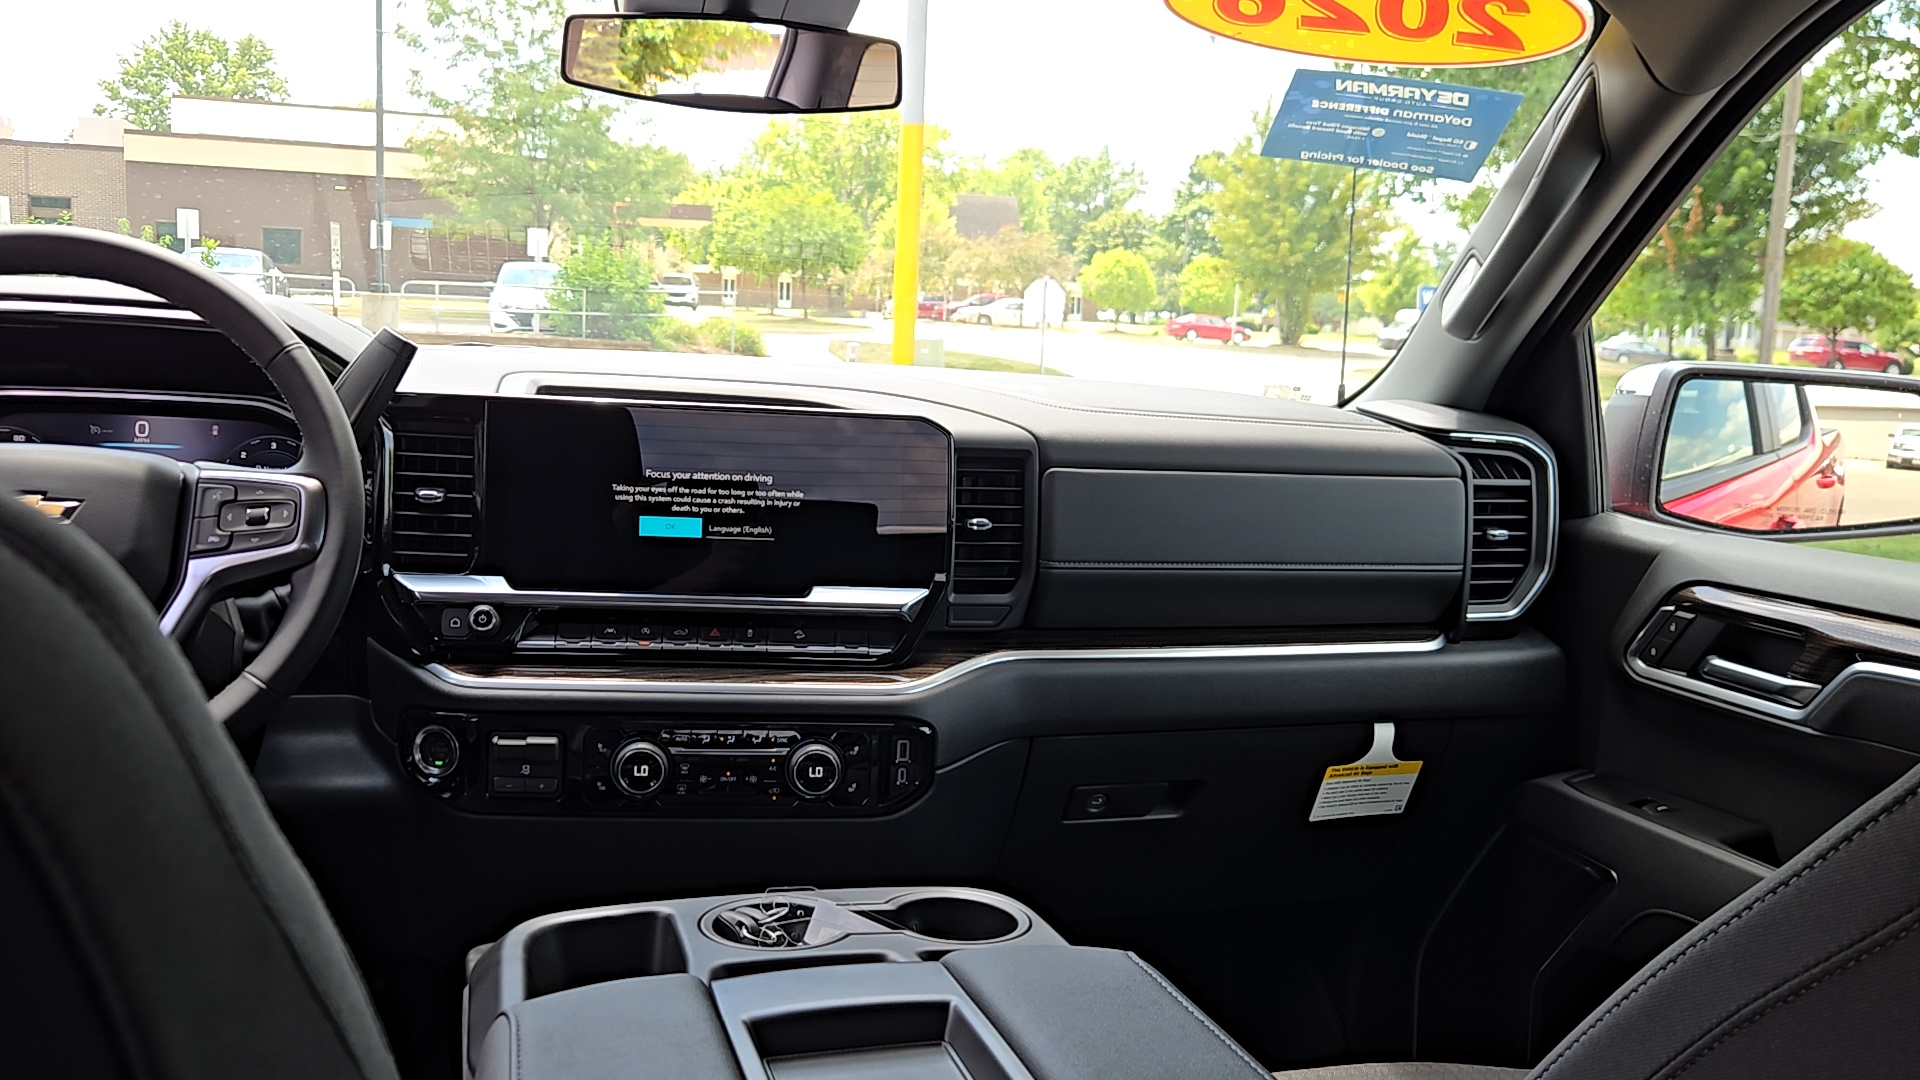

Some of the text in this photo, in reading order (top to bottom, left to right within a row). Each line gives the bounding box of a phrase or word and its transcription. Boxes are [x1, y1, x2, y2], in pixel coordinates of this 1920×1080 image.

[134, 420, 150, 438] 0
[270, 441, 277, 450] 3
[240, 451, 247, 459] 2
[645, 468, 671, 478] Focus
[672, 471, 691, 481] your
[692, 472, 730, 481] attention
[744, 472, 773, 485] driving
[612, 483, 634, 493] Taking
[651, 486, 666, 494] eyes
[679, 486, 690, 494] the
[707, 487, 717, 495] for
[731, 488, 745, 497] long
[755, 489, 766, 497] too
[768, 489, 785, 498] often
[786, 490, 804, 498] while
[615, 494, 633, 502] using
[648, 495, 672, 503] system
[737, 498, 765, 507] resulting
[774, 499, 792, 508] injury
[671, 504, 691, 512] death
[721, 506, 745, 514] others.
[709, 525, 772, 535] Language (English)
